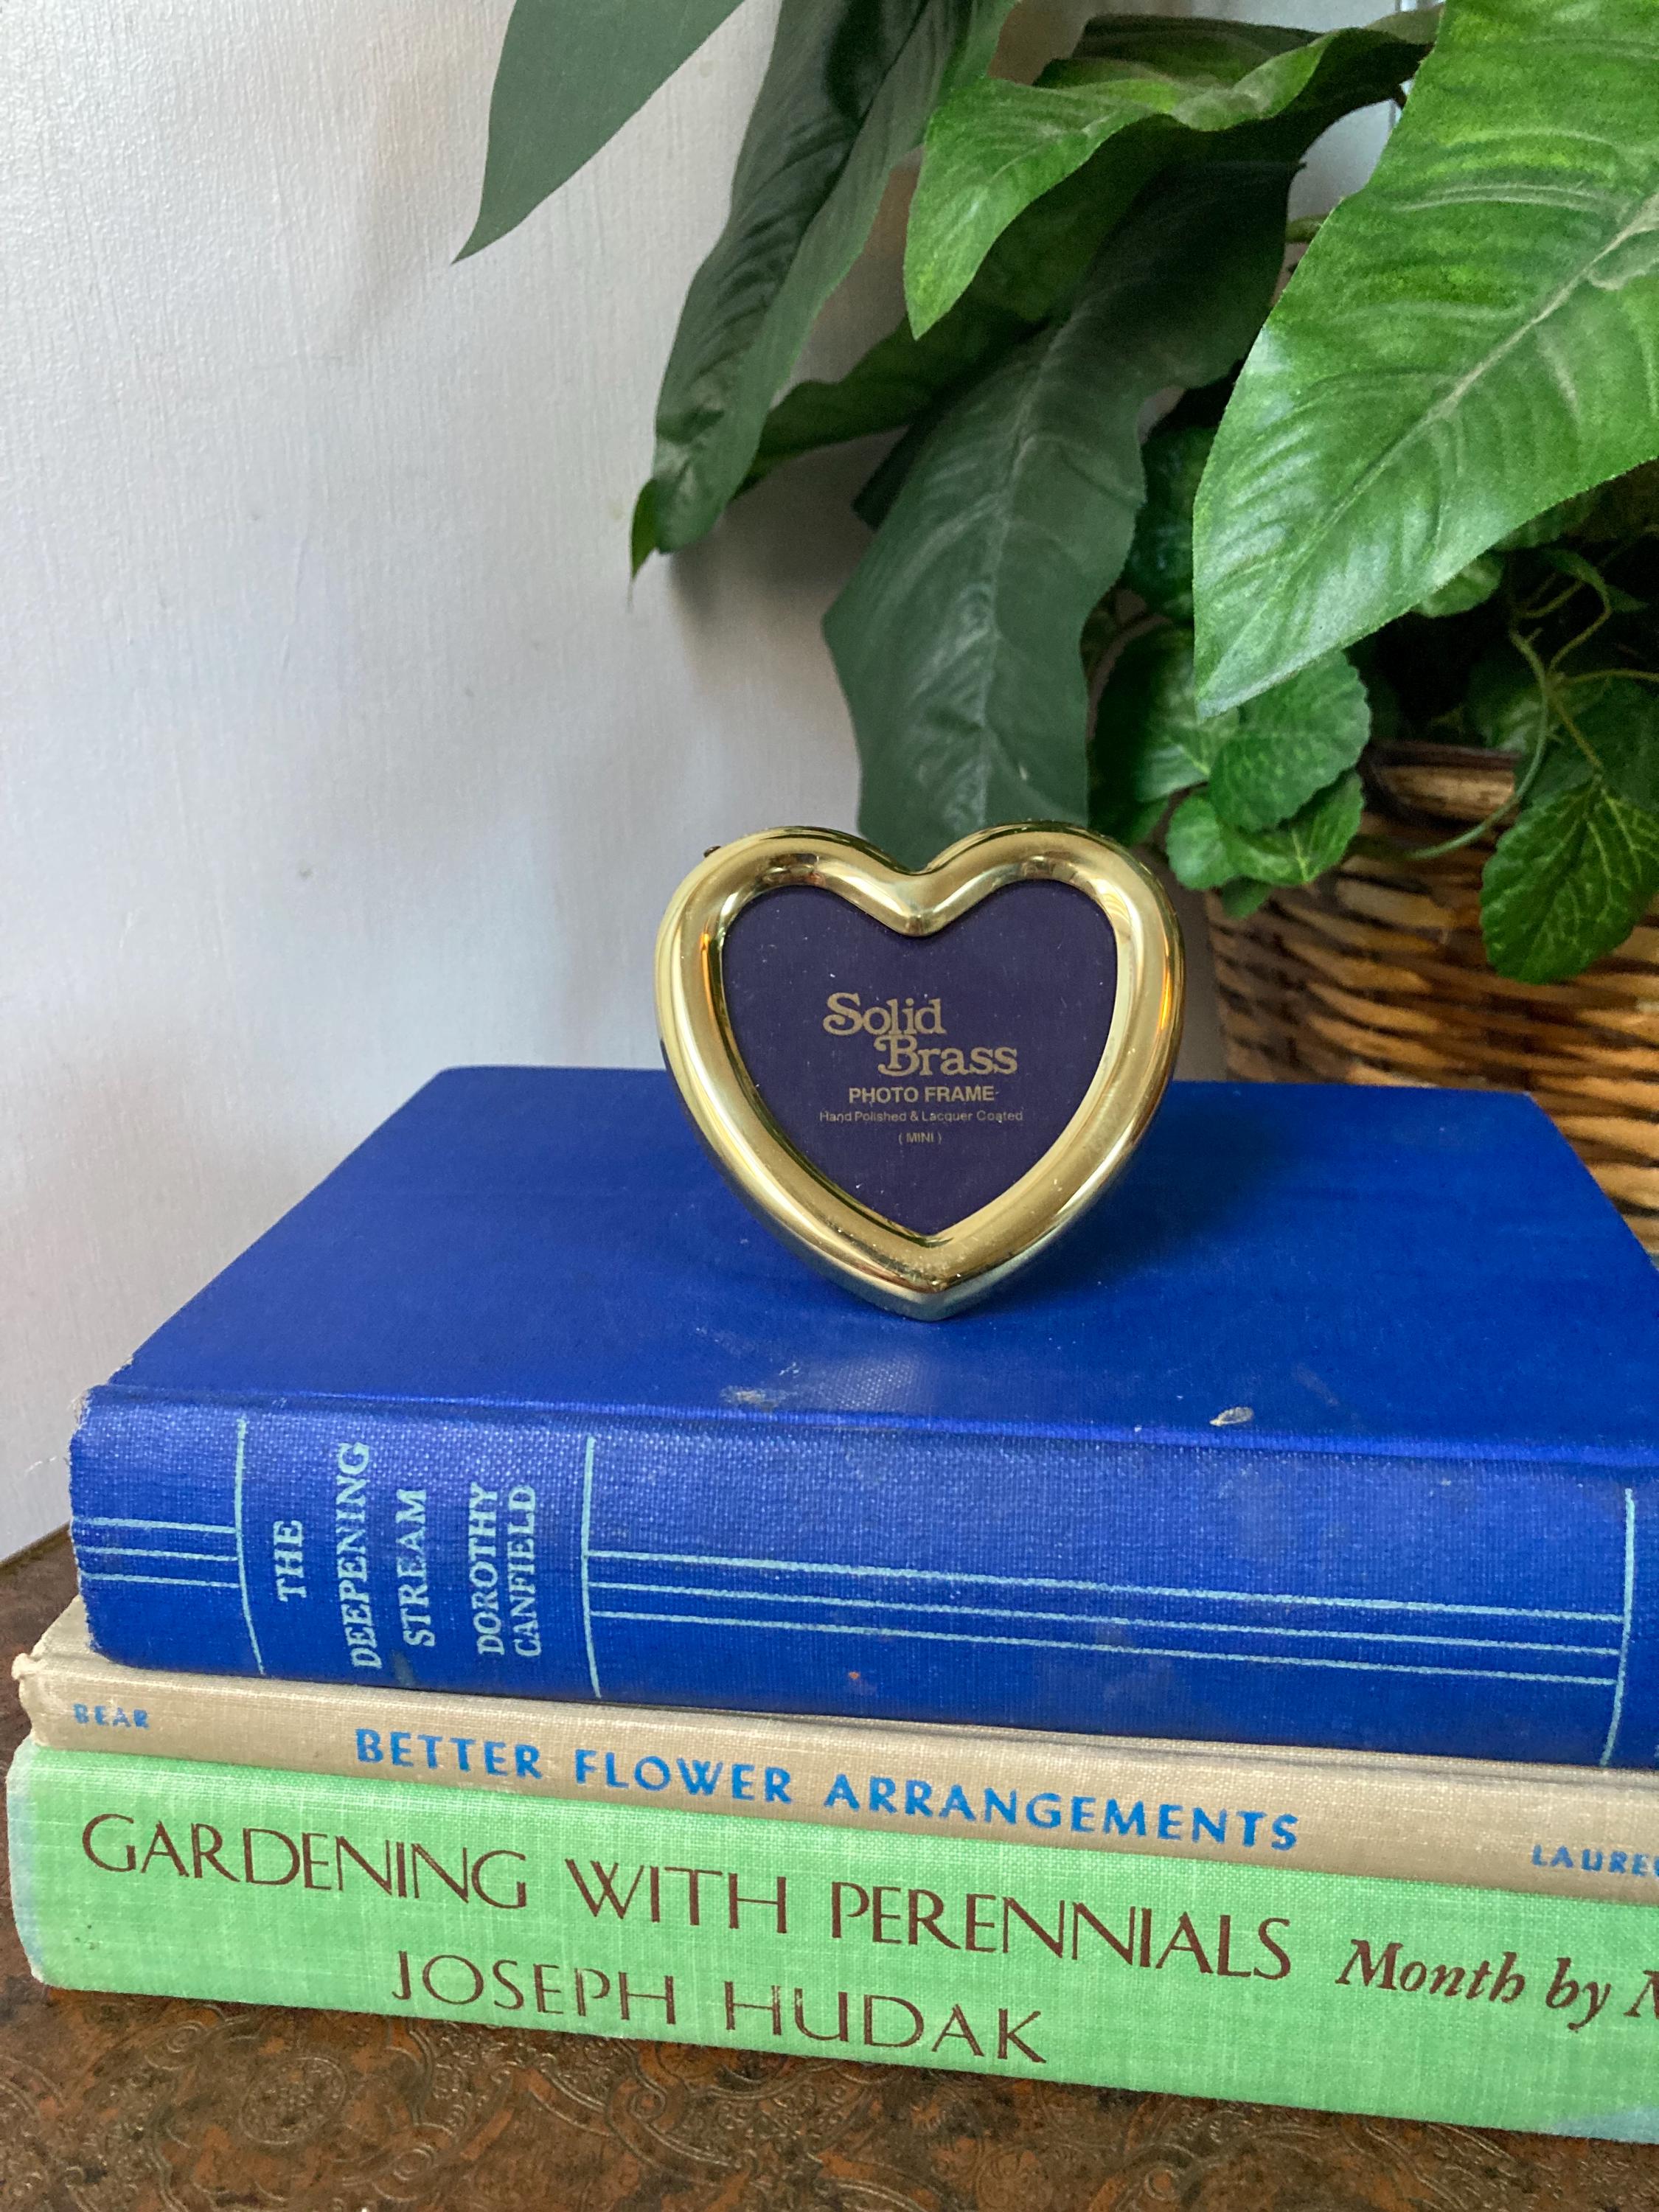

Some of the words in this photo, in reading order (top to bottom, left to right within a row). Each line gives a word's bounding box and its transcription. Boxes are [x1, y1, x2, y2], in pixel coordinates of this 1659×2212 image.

[823, 992, 947, 1034] Solid
[874, 1035, 1018, 1077] Brass
[820, 1111, 852, 1122] Hand
[855, 1111, 907, 1122] Polished
[911, 1112, 919, 1121] &
[922, 1111, 973, 1123] Lacquer
[976, 1110, 1023, 1122] Coated
[849, 1087, 919, 1104] PHOTO
[925, 1086, 994, 1102] FRAME
[273, 1520, 307, 1602] THE
[337, 1441, 382, 1669] DEEPENING
[395, 1489, 436, 1647] STREAM
[467, 1482, 504, 1656] DOROTHY
[507, 1484, 542, 1658] CANFIELD
[74, 1703, 149, 1729] BEAR
[355, 1728, 541, 1779] BETTER
[575, 1748, 792, 1804] FLOWER
[823, 1773, 1298, 1851] ARRANGEMENTS
[81, 1813, 527, 1909] GARDENING
[565, 1857, 787, 1934] WITH
[830, 1881, 1292, 1980] PERENNIALS
[1335, 1938, 1526, 2003] Month
[1545, 1957, 1611, 2033] by
[392, 1950, 676, 2025] JOSEPH
[724, 1980, 1047, 2065] HUDAK
